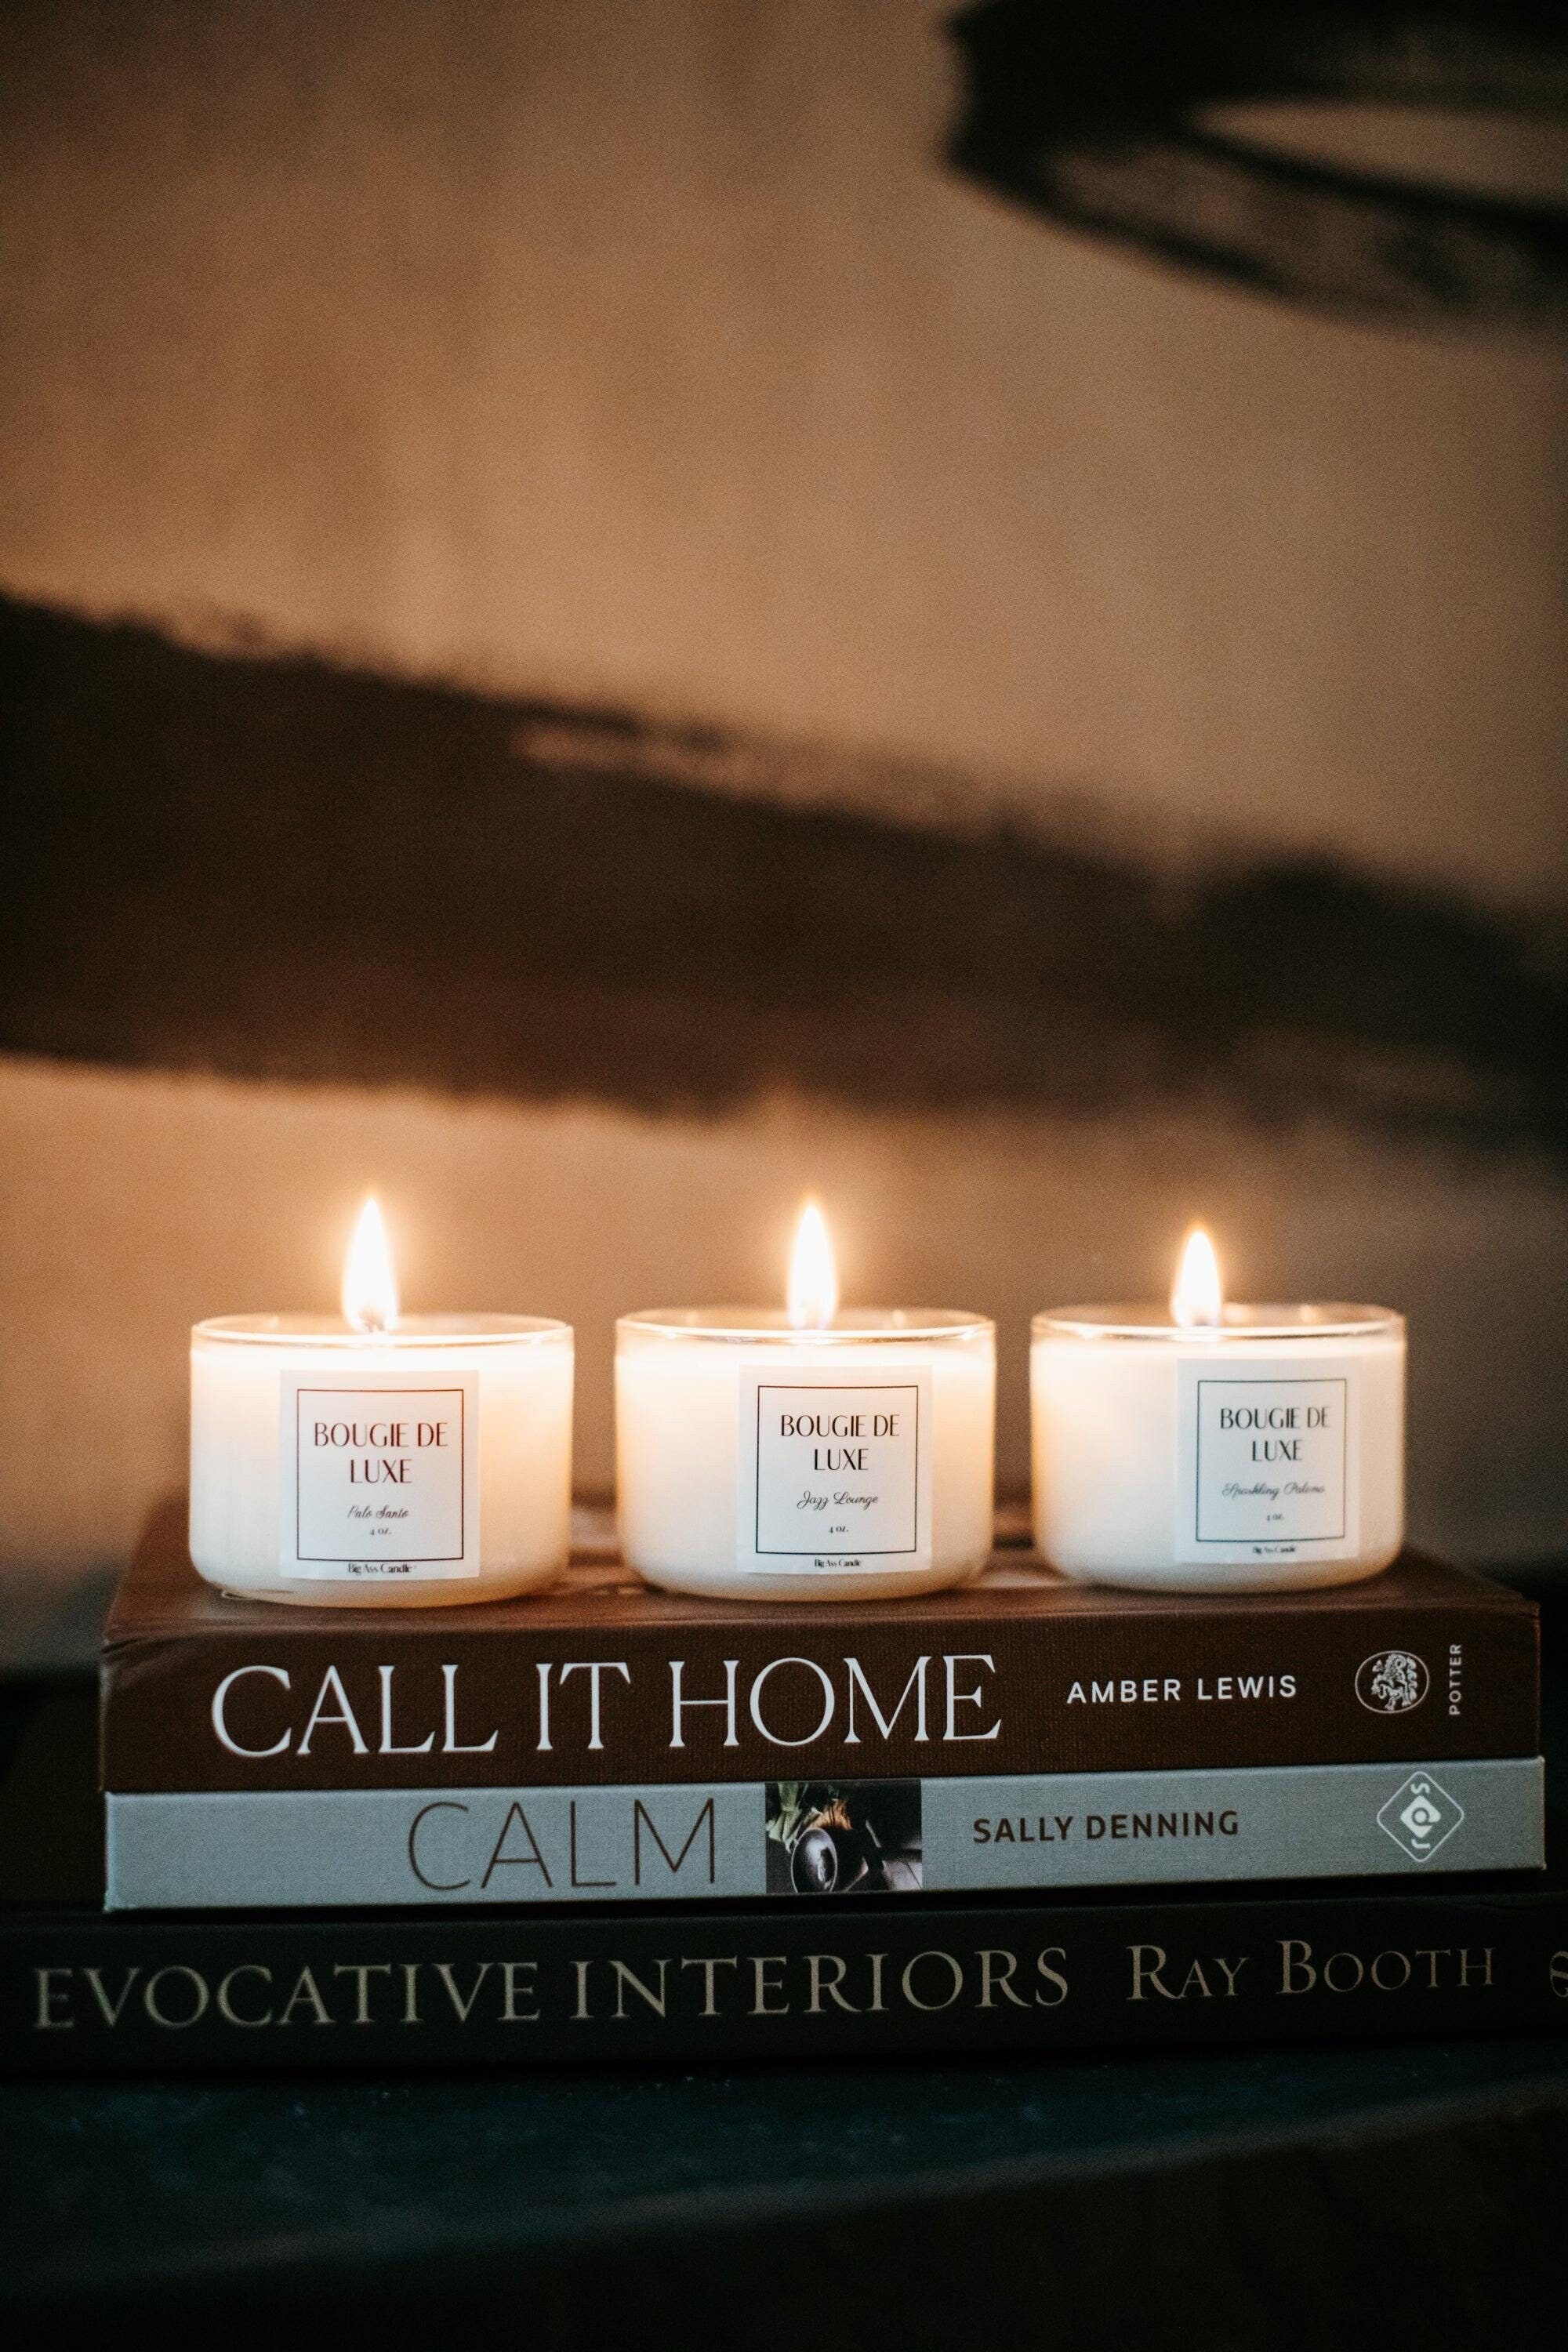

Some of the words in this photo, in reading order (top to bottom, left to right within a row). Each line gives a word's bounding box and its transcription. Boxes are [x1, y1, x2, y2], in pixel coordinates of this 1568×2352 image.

[780, 1414, 867, 1438] BOUGIE
[873, 1414, 900, 1437] DE
[1220, 1407, 1301, 1430] BOUGIE
[1307, 1406, 1330, 1428] DE
[314, 1421, 410, 1447] BOUGIE
[417, 1422, 448, 1447] DE
[813, 1448, 869, 1472] LUXE
[1251, 1439, 1303, 1462] LUXE
[350, 1458, 413, 1484] LUXE
[347, 1505, 372, 1519] Palo
[376, 1504, 409, 1519] Santo
[797, 1490, 829, 1512] Jazz
[833, 1491, 879, 1511] Lounge
[347, 1563, 361, 1576] Big
[364, 1563, 379, 1573] Ass
[380, 1563, 412, 1573] Candle
[1066, 1679, 1181, 1704] AMBER
[1196, 1675, 1298, 1701] LEWIS
[1448, 1643, 1463, 1716] POTTER
[211, 1664, 500, 1759] CALL
[535, 1661, 631, 1751] IT
[668, 1653, 1002, 1748] HOME
[972, 1816, 1075, 1845] SALLY
[1086, 1810, 1240, 1841] DENNING
[408, 1797, 716, 1892] CALM
[32, 1961, 541, 2029] EVOCATIVE
[568, 1946, 1069, 2020] INTERIORS
